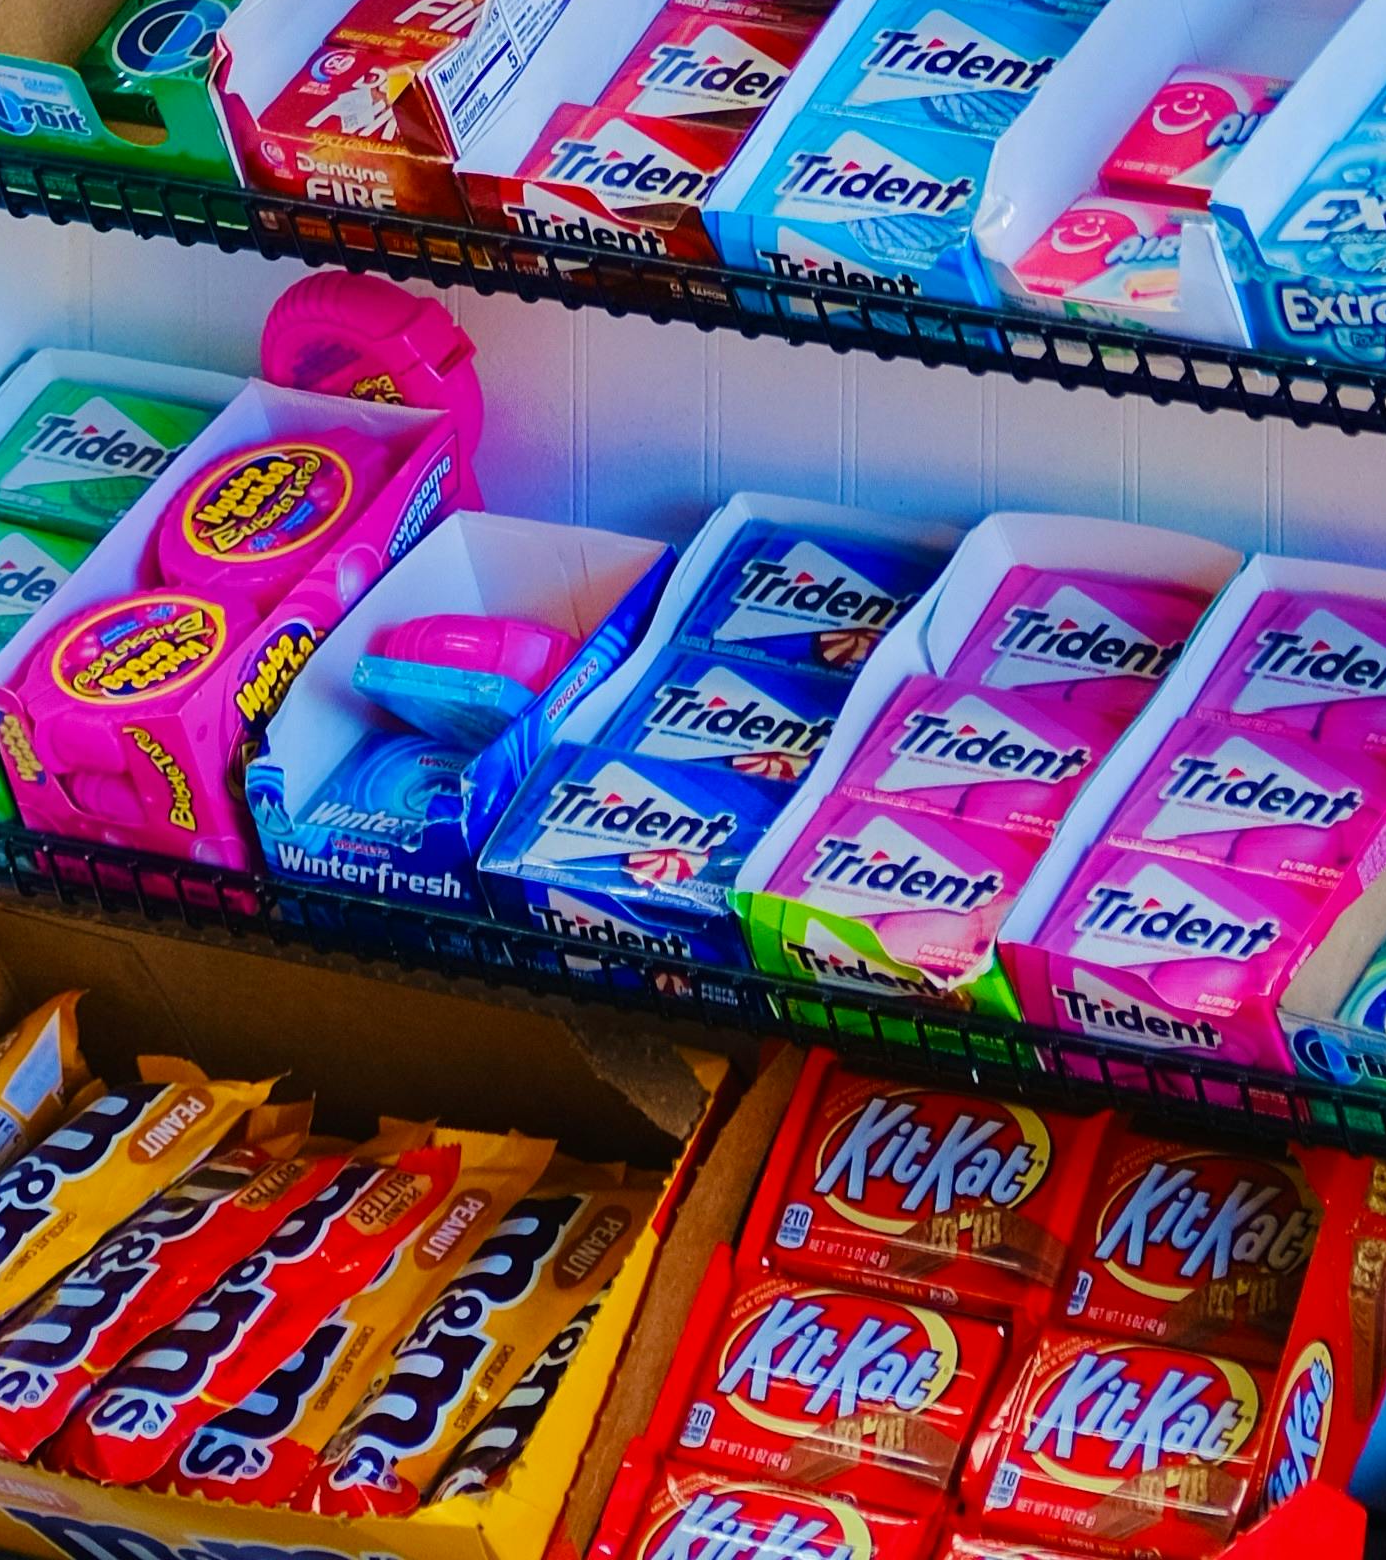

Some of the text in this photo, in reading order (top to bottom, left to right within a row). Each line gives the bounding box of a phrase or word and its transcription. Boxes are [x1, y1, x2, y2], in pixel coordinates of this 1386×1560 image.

[293, 150, 389, 188] Dentyne
[306, 178, 397, 212] FIRE
[790, 146, 973, 215] Trident
[908, 714, 1093, 783] Trident
[552, 780, 738, 852] Trident
[275, 843, 463, 900] Winterfresh
[821, 837, 1005, 912] Trident
[1055, 984, 1223, 1050] Trident
[134, 1093, 208, 1162] PEANUT
[419, 1192, 490, 1266] PEANUT
[782, 1204, 810, 1228] 210
[715, 1295, 947, 1420] KitKat
[1022, 1351, 1247, 1465] KitKat
